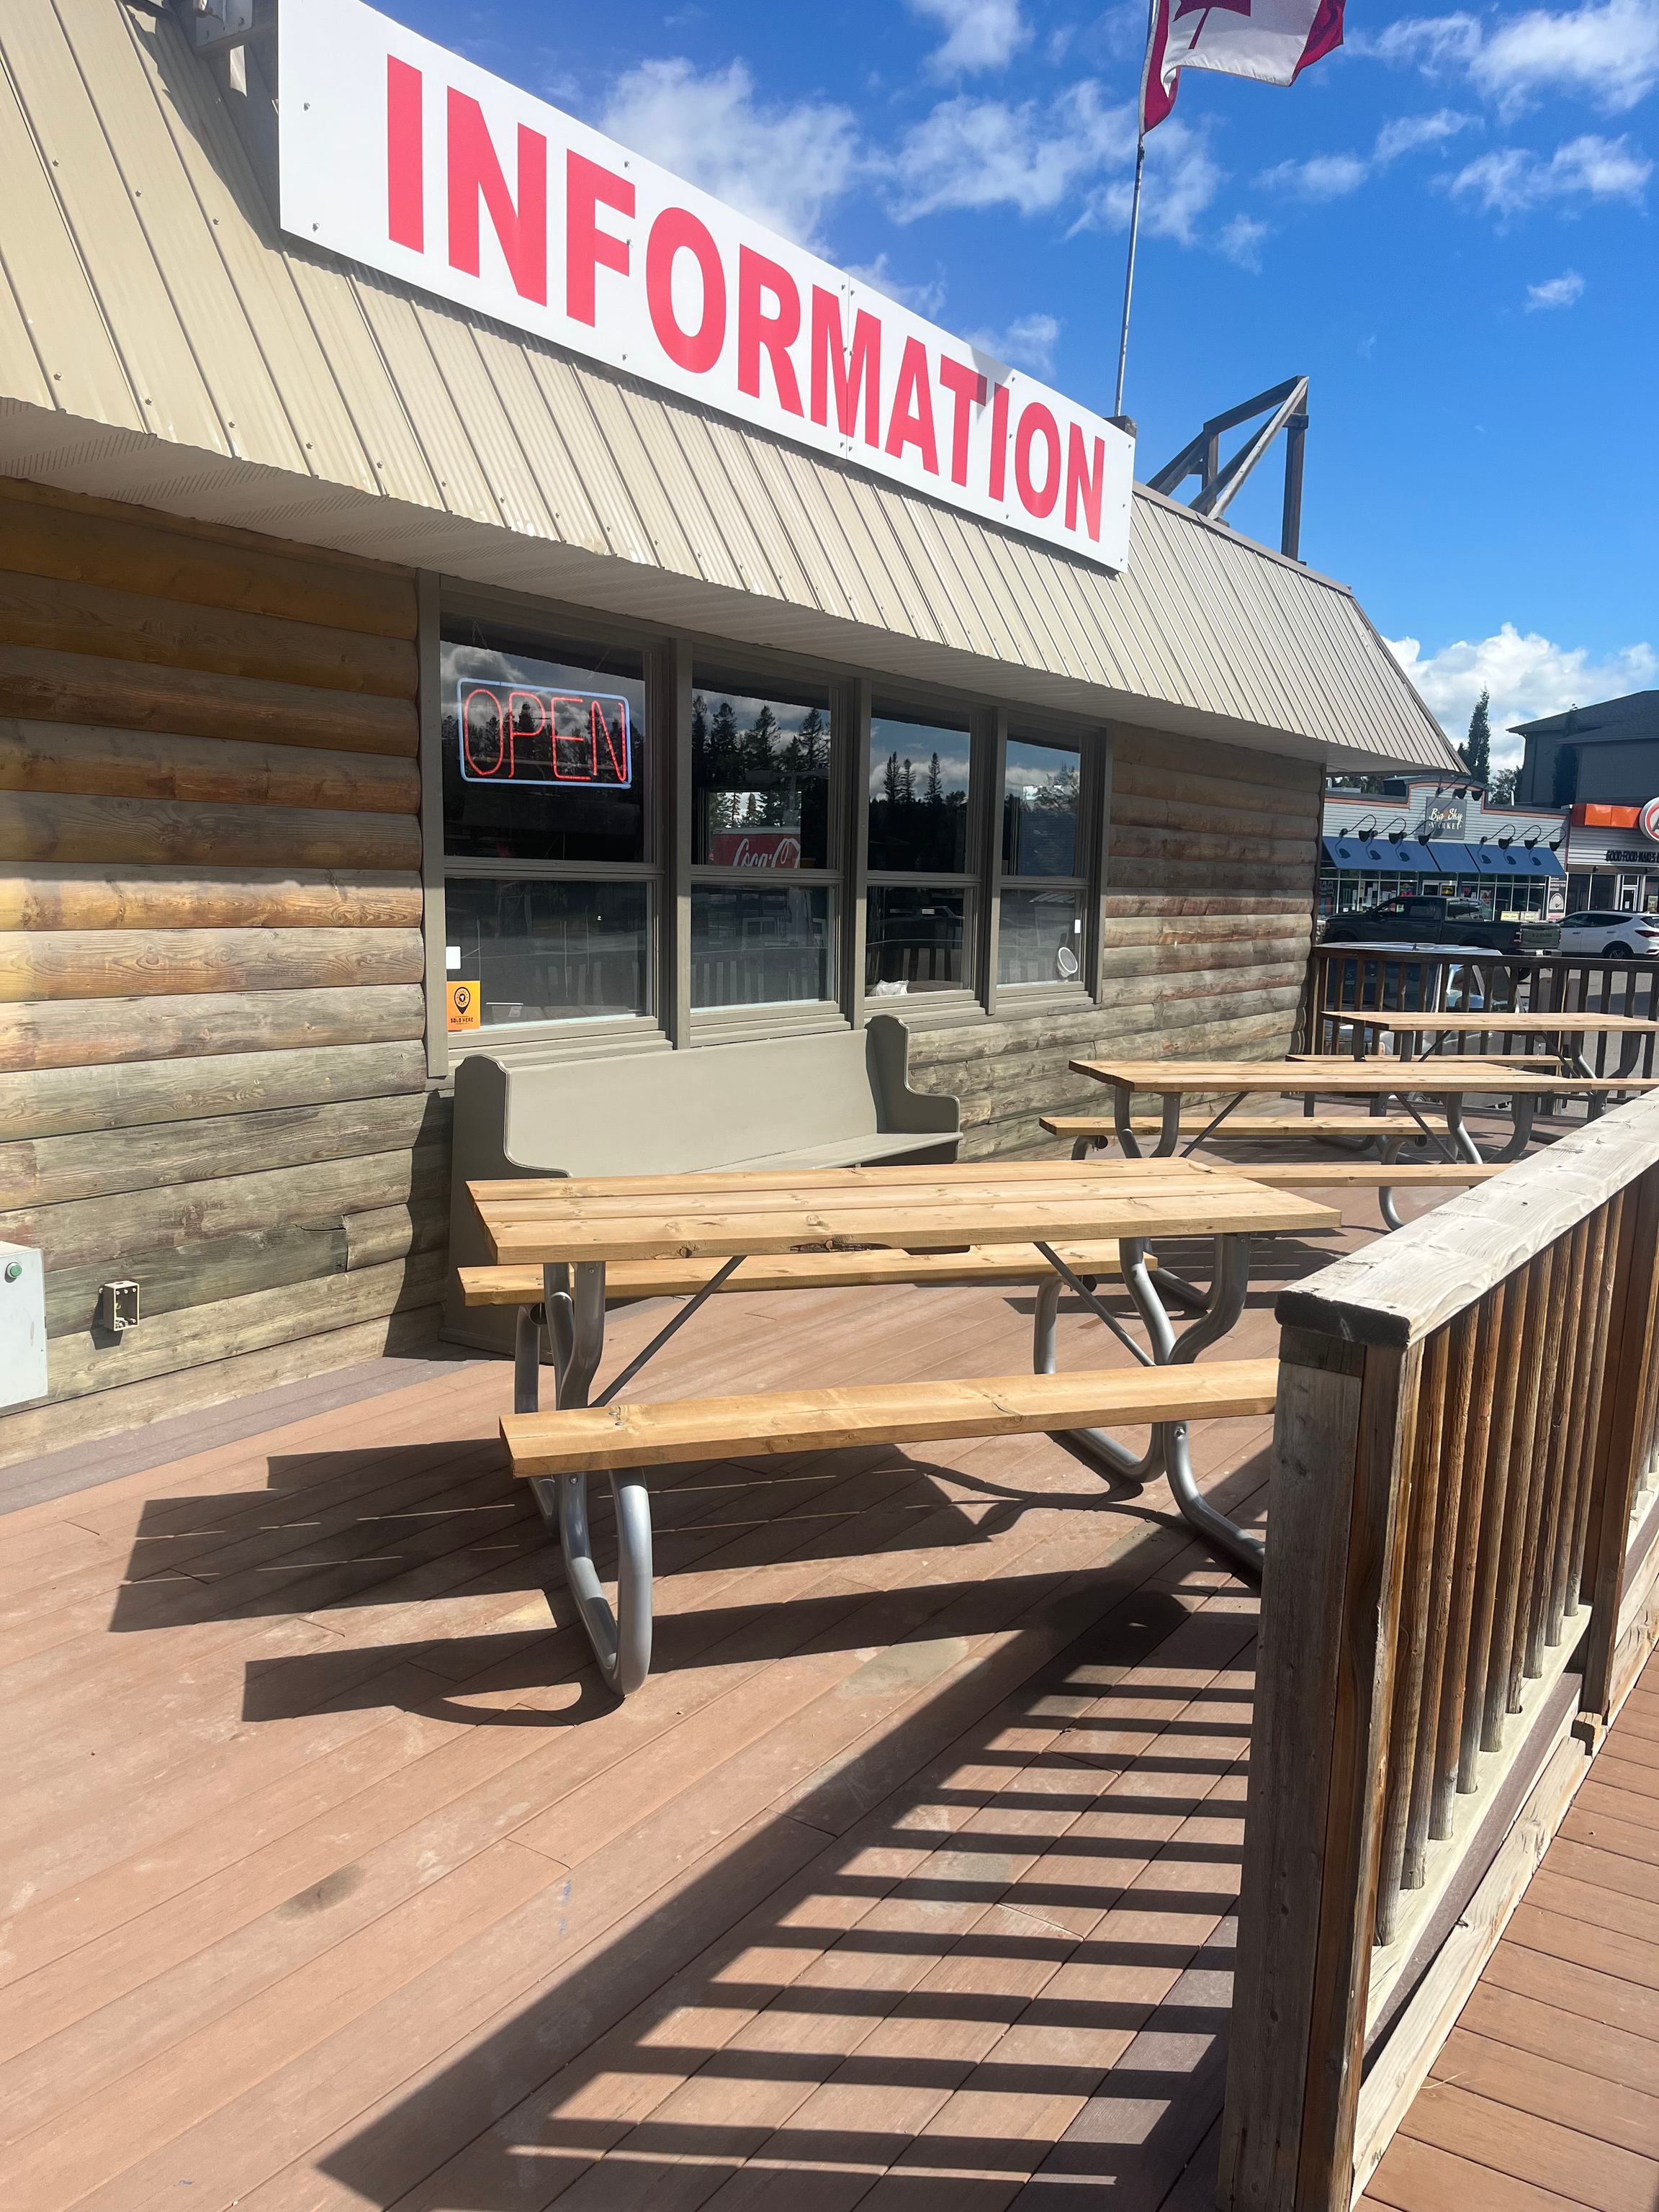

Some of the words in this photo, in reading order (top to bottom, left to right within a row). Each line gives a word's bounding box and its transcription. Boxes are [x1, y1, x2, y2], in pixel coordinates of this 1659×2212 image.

[387, 53, 1105, 543] INFORMATION
[464, 688, 626, 781] OPEN
[1429, 808, 1444, 822] Big
[1447, 808, 1463, 824] Sky
[1606, 850, 1622, 861] GOOD
[1623, 850, 1637, 862] FOOD
